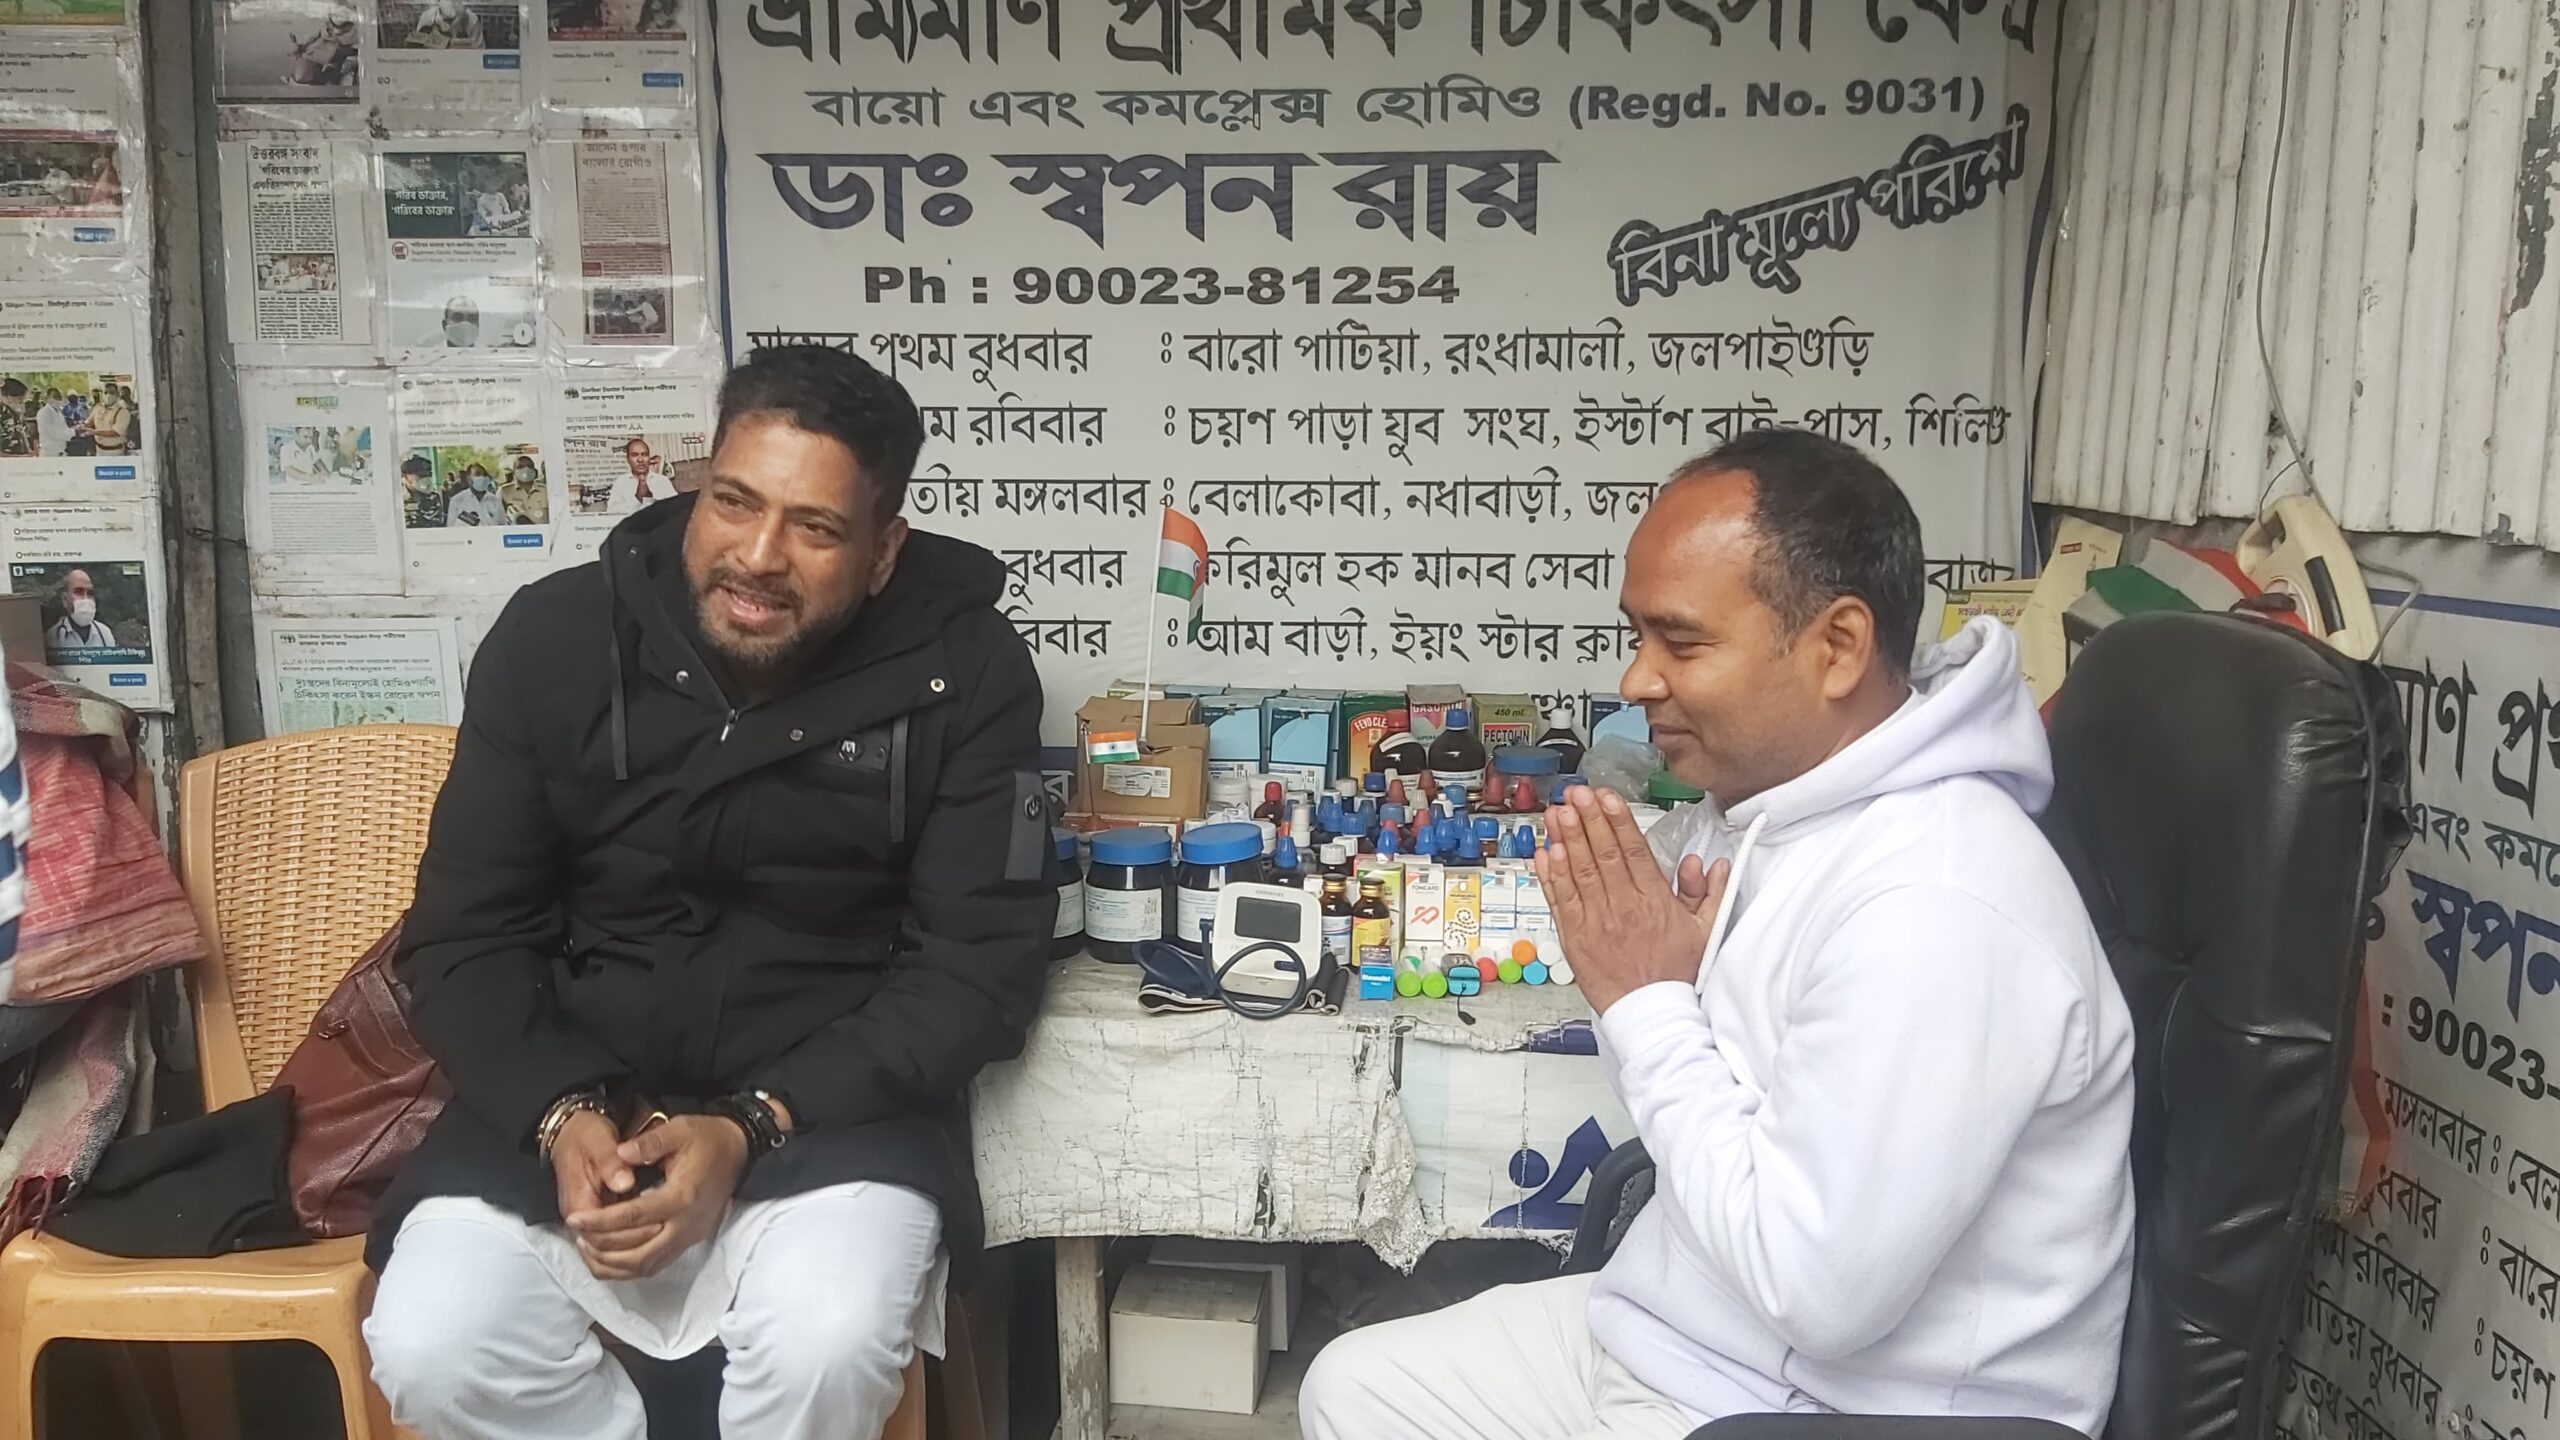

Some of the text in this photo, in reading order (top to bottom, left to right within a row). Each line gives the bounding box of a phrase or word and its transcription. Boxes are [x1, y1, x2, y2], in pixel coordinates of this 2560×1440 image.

[804, 73, 1985, 131] বায়ো এবং কমপ্লেক্স হোমিও (Regd. No. 9031)
[756, 154, 973, 244] ডাঃ
[990, 154, 1320, 251] স্বপন
[1318, 150, 1562, 243] রায়
[1609, 211, 1731, 305] বিনা
[1736, 180, 1860, 291] মূল্যে
[864, 267, 946, 304] Ph
[1013, 265, 1460, 305] 90023-81254
[964, 327, 1093, 391] বুধবার
[1183, 328, 1283, 375] বারো
[1294, 318, 1431, 376] পাটিয়া,
[1443, 317, 1635, 376] রংধামালী,
[1648, 315, 1875, 378] জলপাইগুড়ি
[967, 391, 1107, 446] রবিবার
[1287, 401, 1373, 450] পাড়া
[1381, 408, 1445, 466] যুব
[1463, 407, 1561, 449] সংঘ,
[992, 472, 1151, 518] মঙ্গলবার
[1189, 474, 1391, 520] বেলাকোবা,
[1001, 544, 1128, 605] বুধবার
[1335, 552, 1403, 592] হক
[1412, 546, 1516, 589] মানব
[1525, 547, 1615, 590] সেবা
[1196, 615, 1274, 657] আম
[1389, 606, 1470, 663] ইয়ং
[1477, 608, 1564, 662] স্টার
